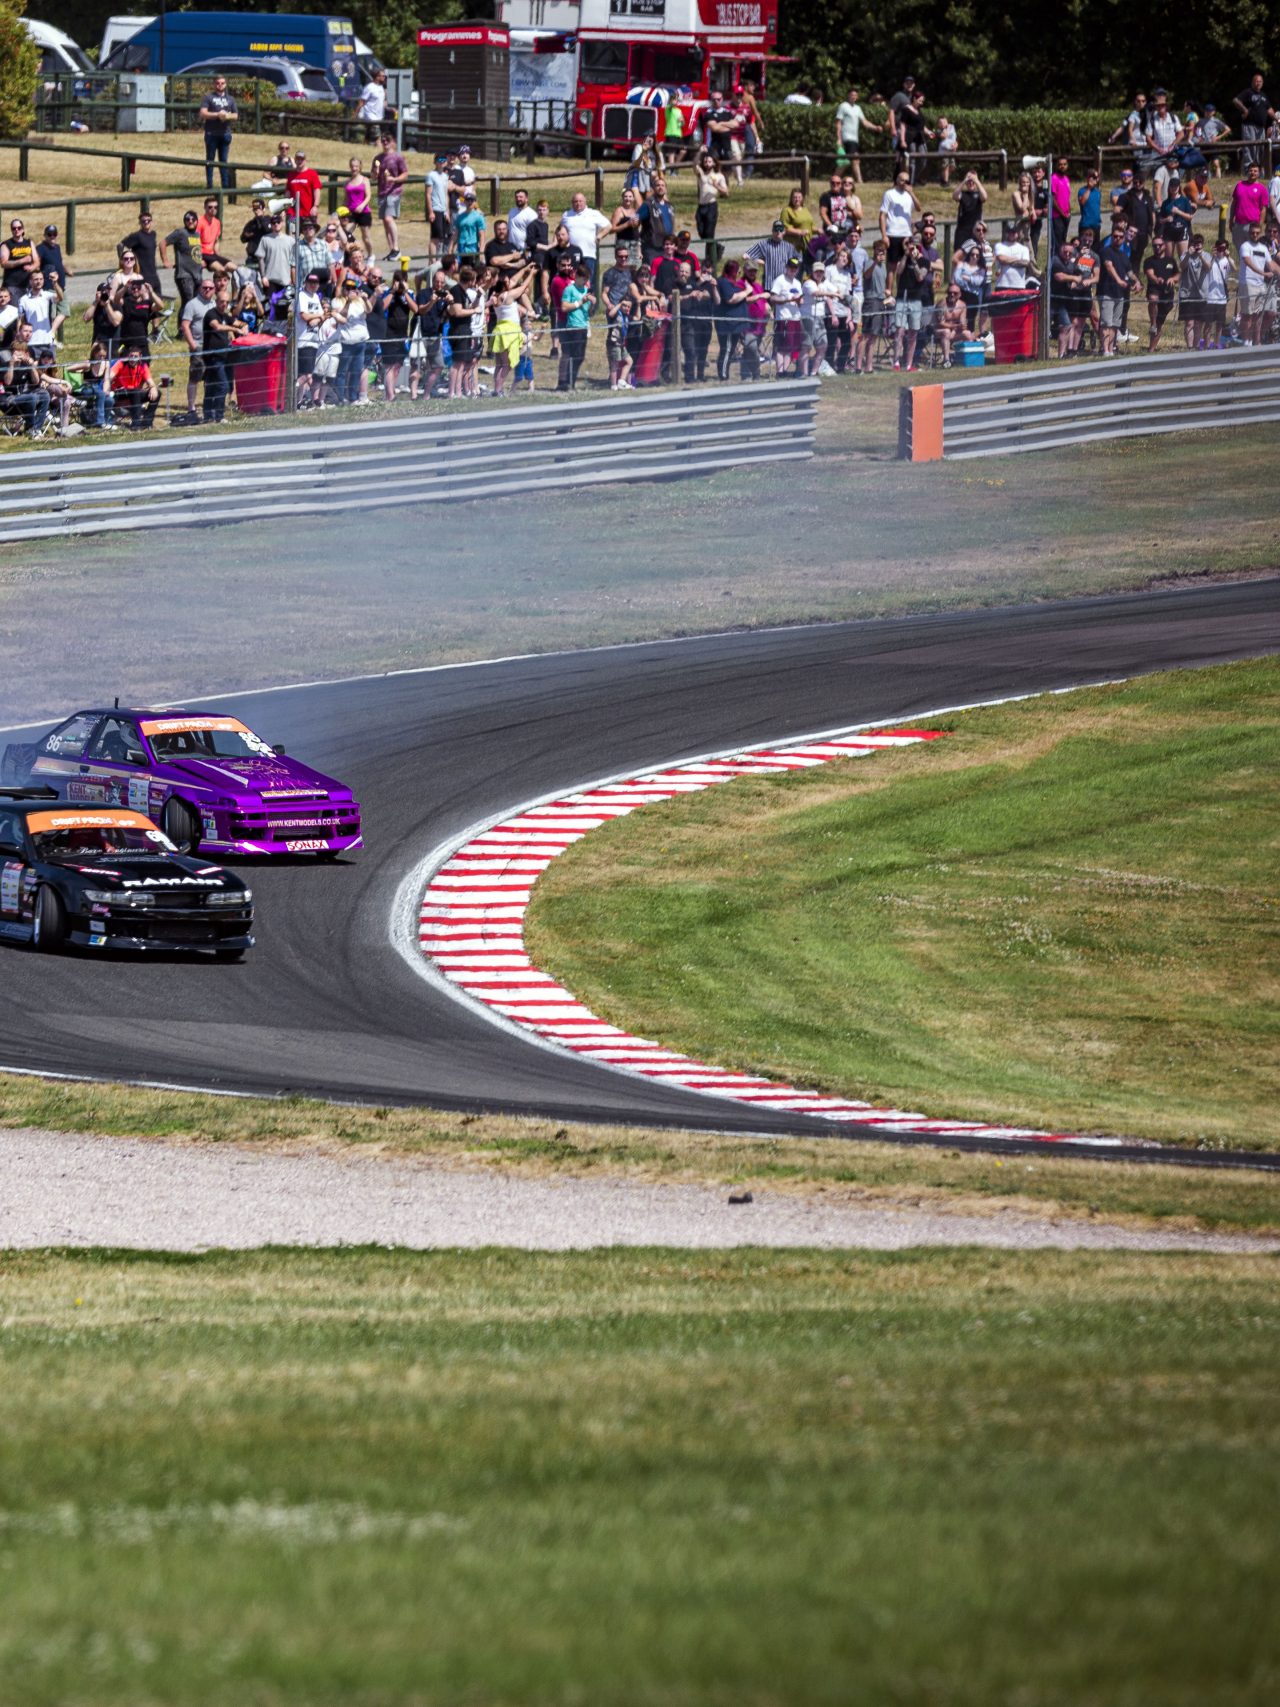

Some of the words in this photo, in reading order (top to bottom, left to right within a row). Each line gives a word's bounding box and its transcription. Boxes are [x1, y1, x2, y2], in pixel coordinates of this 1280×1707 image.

[421, 31, 483, 43] Programmes
[46, 734, 63, 752] 86
[70, 782, 87, 794] KENT
[267, 817, 341, 828] WWW.KENTMODELS.CO.UK
[287, 841, 325, 851] SONAX
[122, 877, 225, 888] RAMAIR
